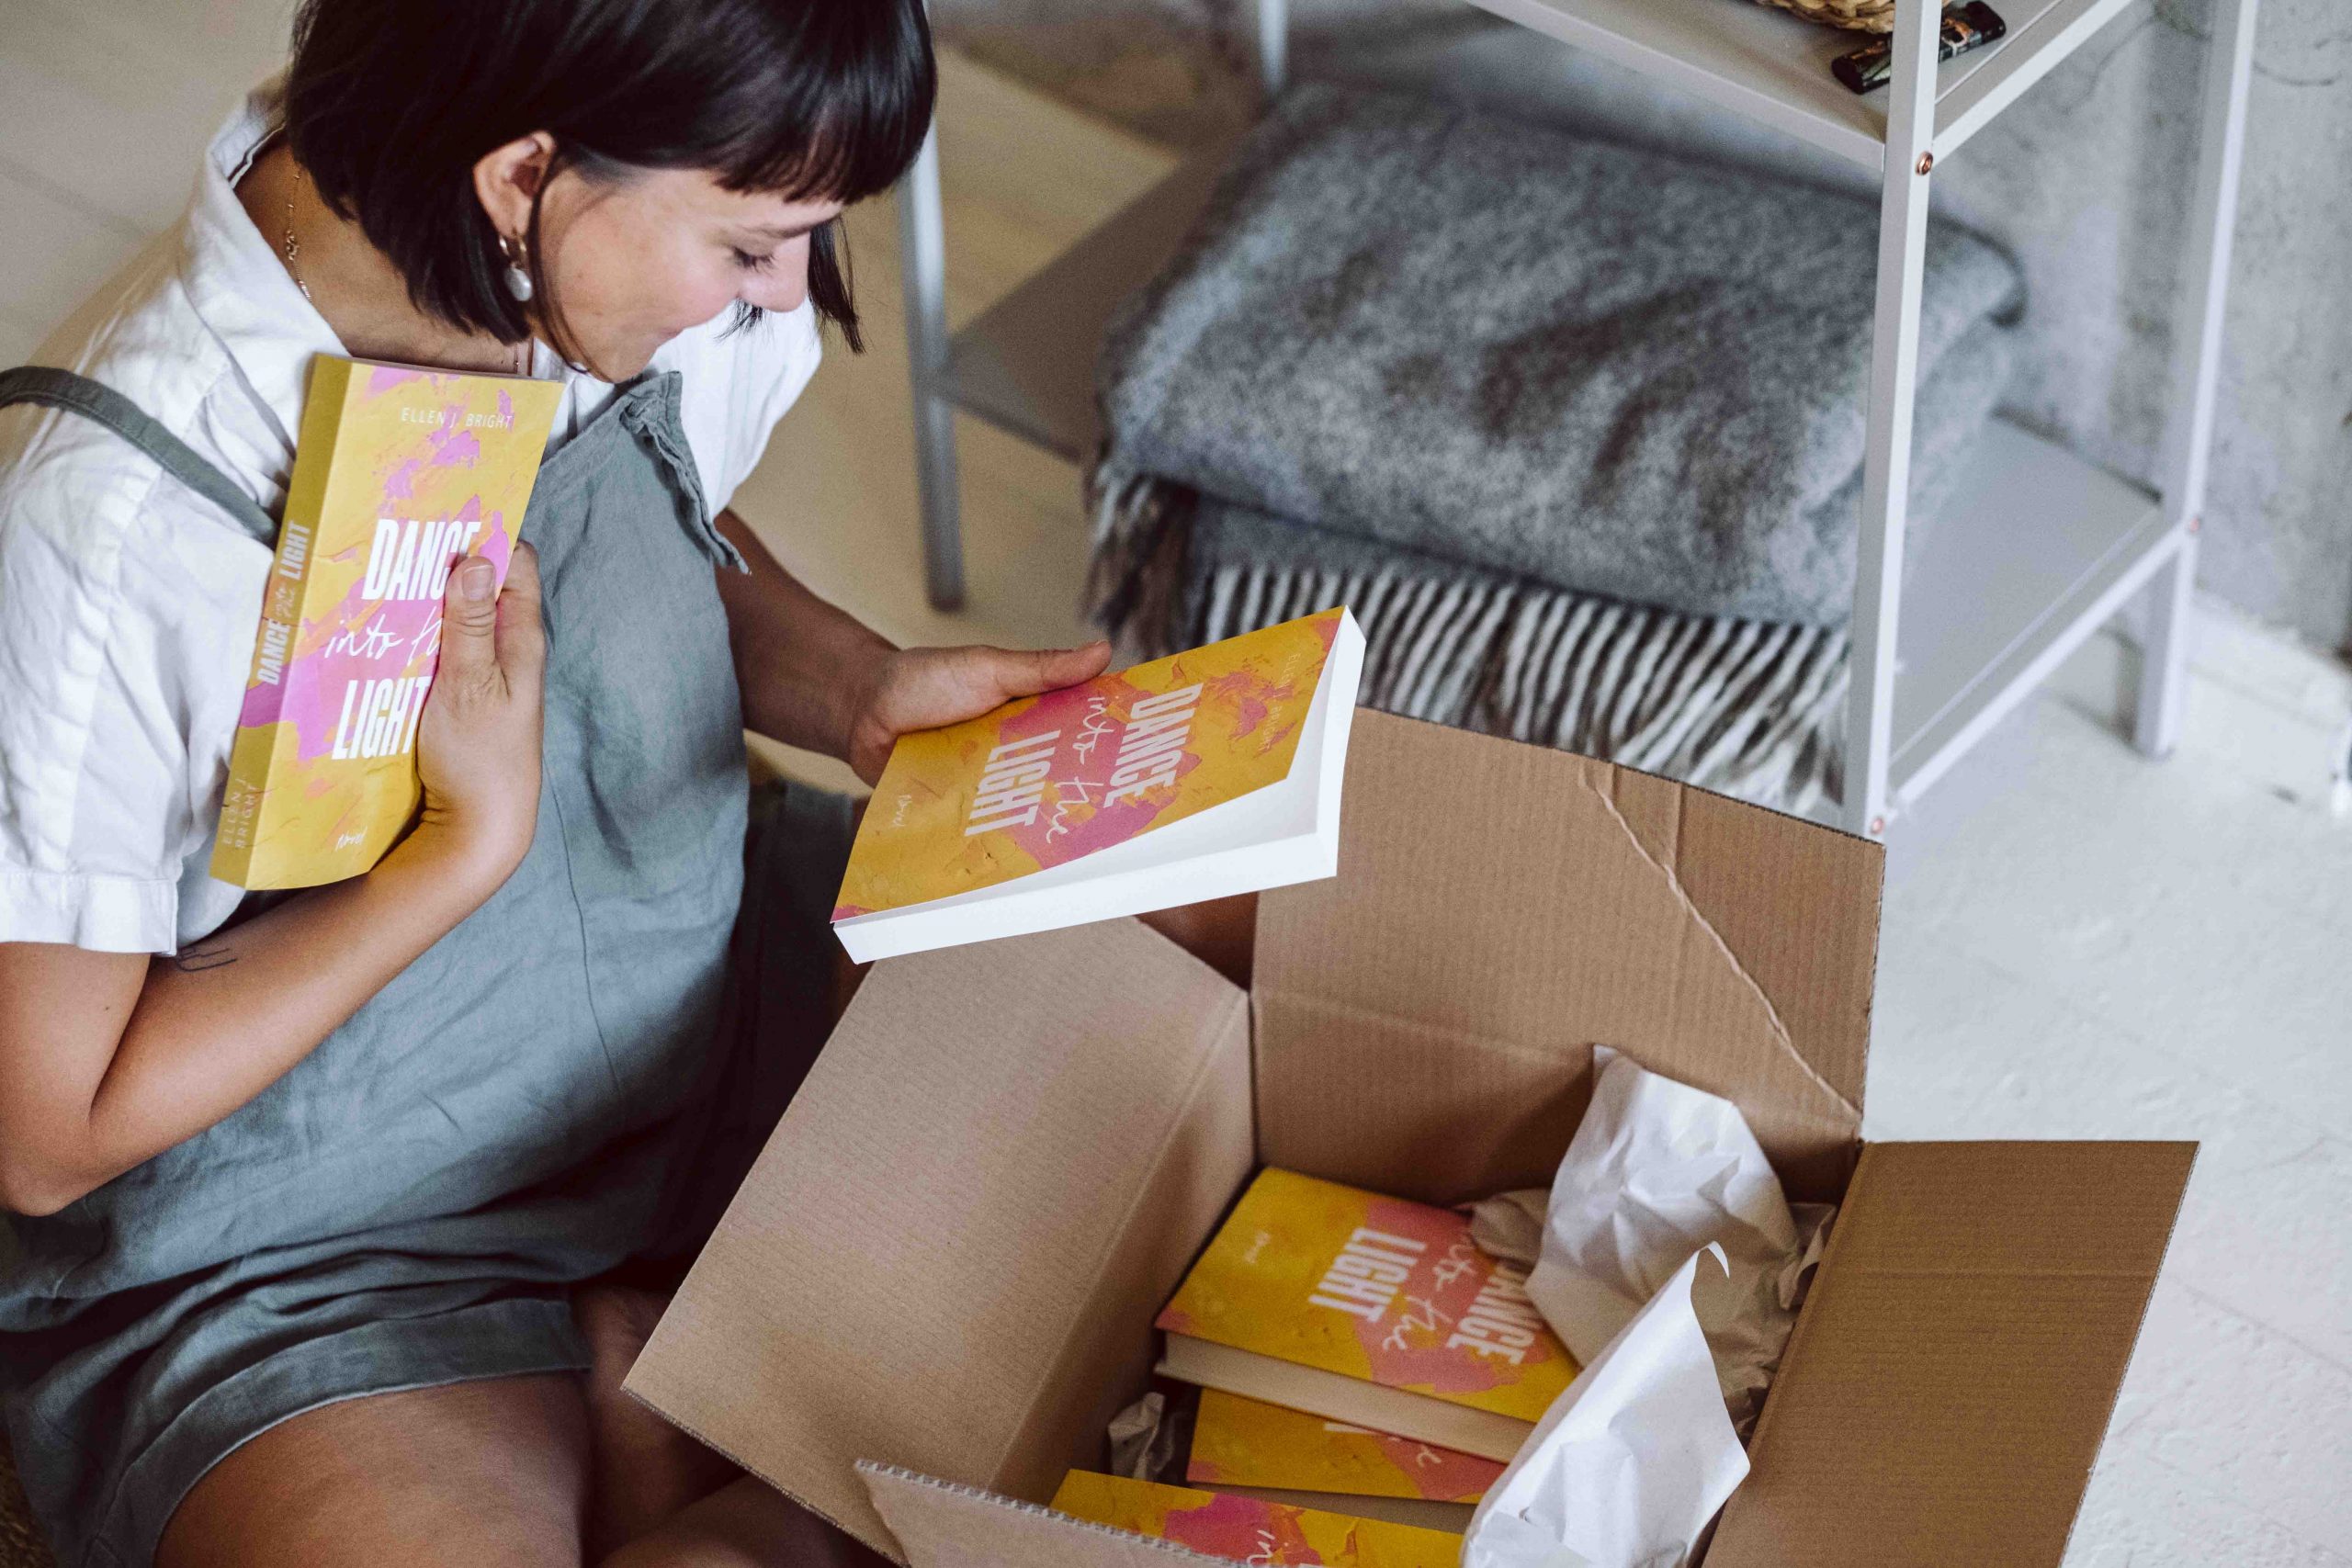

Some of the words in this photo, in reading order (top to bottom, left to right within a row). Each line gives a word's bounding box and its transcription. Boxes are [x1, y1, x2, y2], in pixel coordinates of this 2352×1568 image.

[401, 407, 447, 426] ELLEN
[464, 413, 514, 429] BRIGHT
[257, 617, 292, 685] DANCE
[278, 519, 311, 581] LIGHT
[324, 614, 404, 660] into
[332, 676, 433, 761] LIGHT
[1072, 695, 1116, 765] into
[1103, 682, 1204, 808] DANCE
[965, 729, 1061, 838] LIGHT
[1046, 776, 1104, 844] the
[1307, 1226, 1427, 1323] LIGHT
[1382, 1294, 1454, 1351] the
